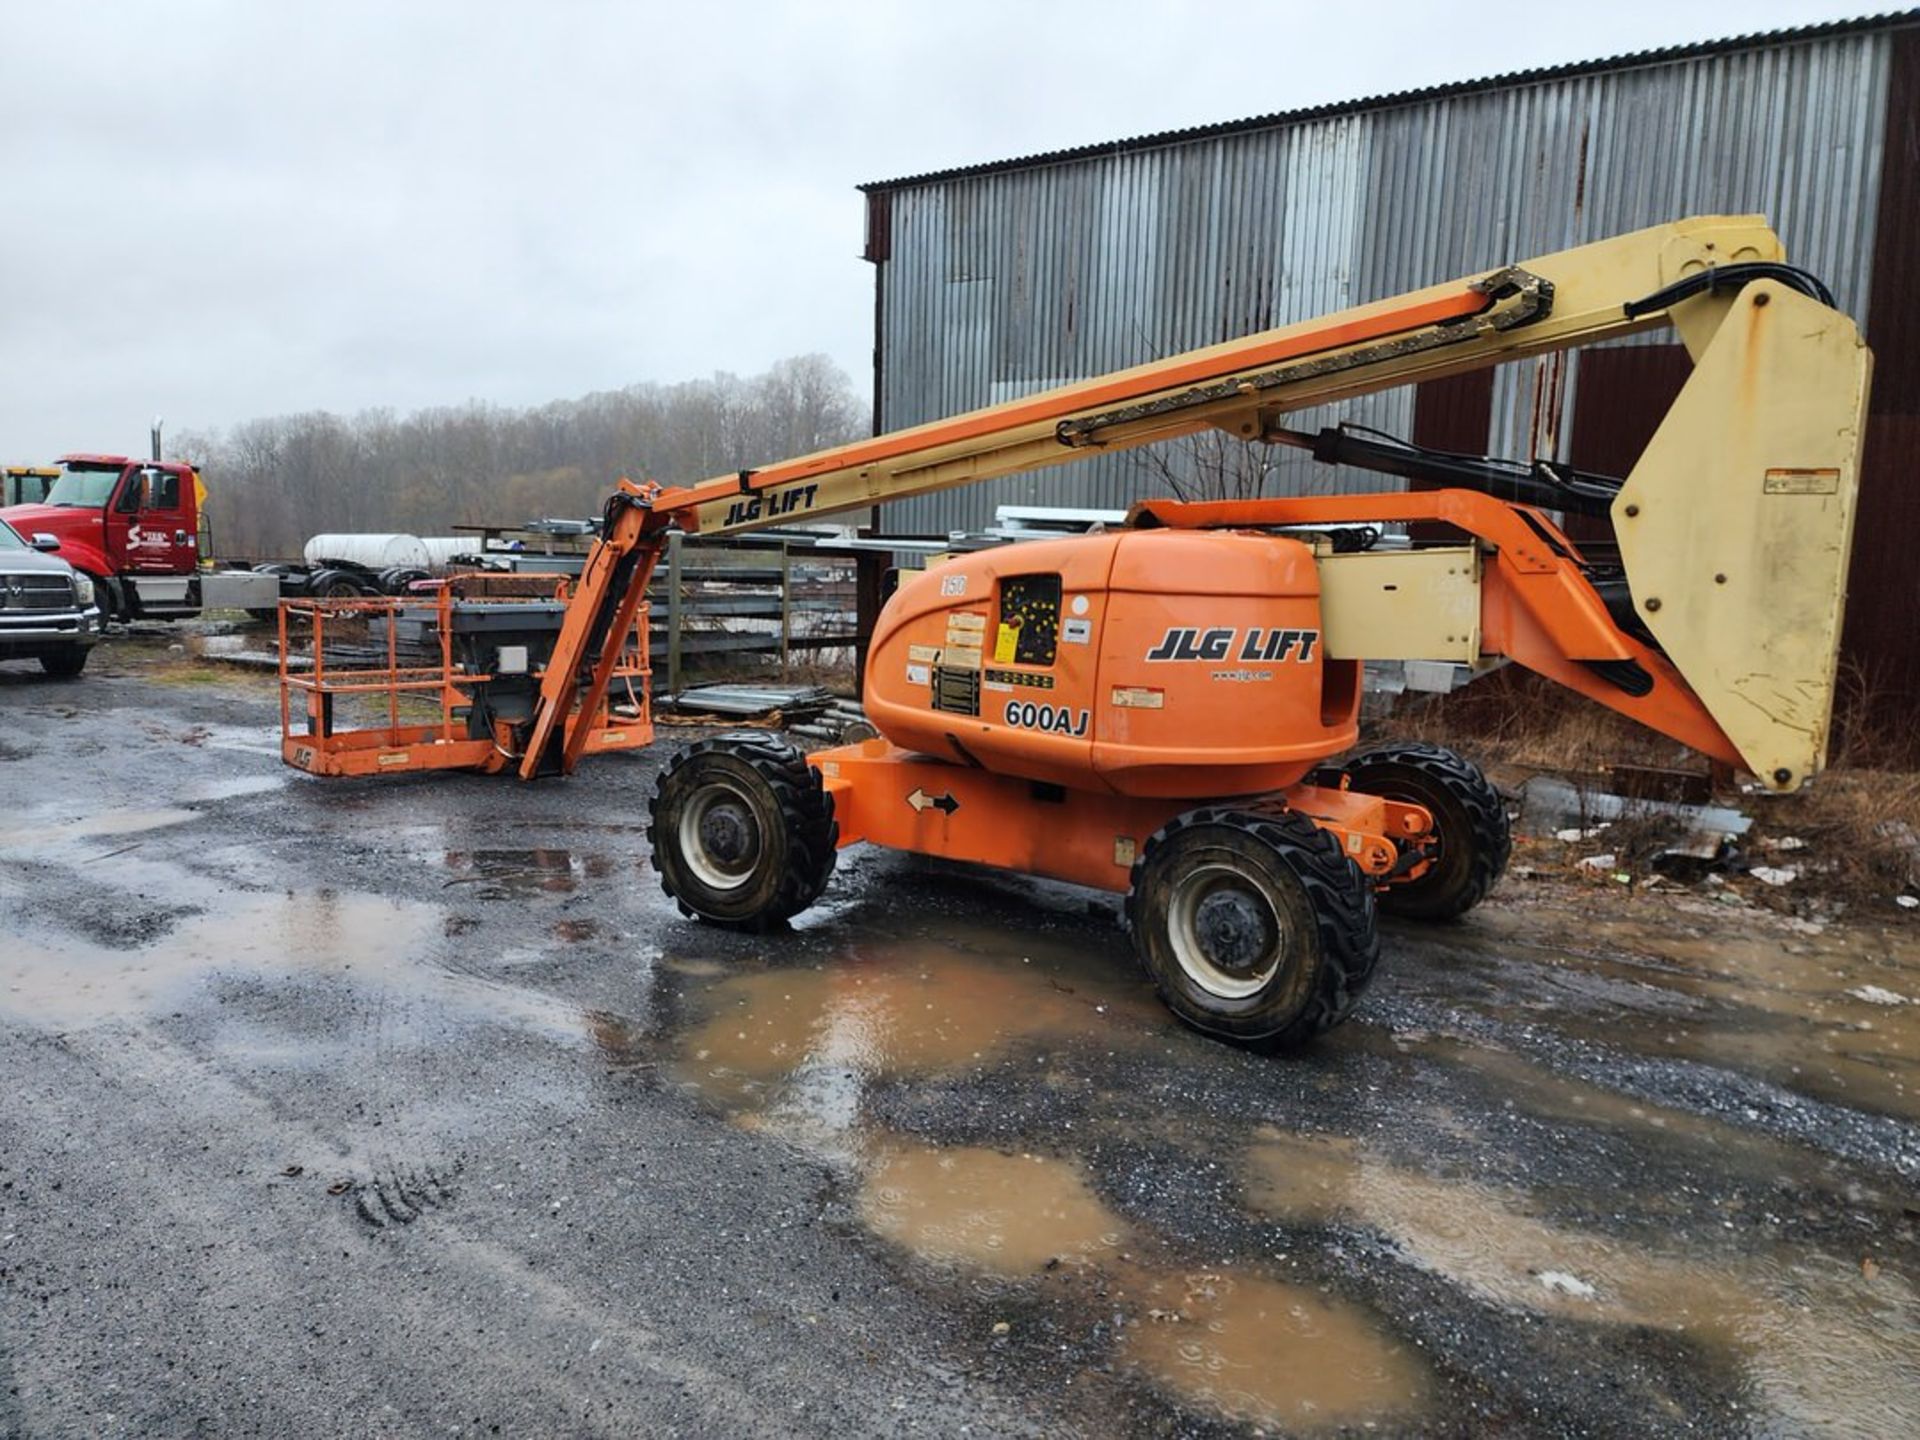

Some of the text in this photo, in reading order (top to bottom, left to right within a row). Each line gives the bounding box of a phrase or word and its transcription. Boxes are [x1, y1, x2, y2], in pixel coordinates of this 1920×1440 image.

[723, 484, 818, 527] JLG LIFT
[1146, 628, 1319, 662] JLG LIFT
[1005, 701, 1089, 736] 600AJ
